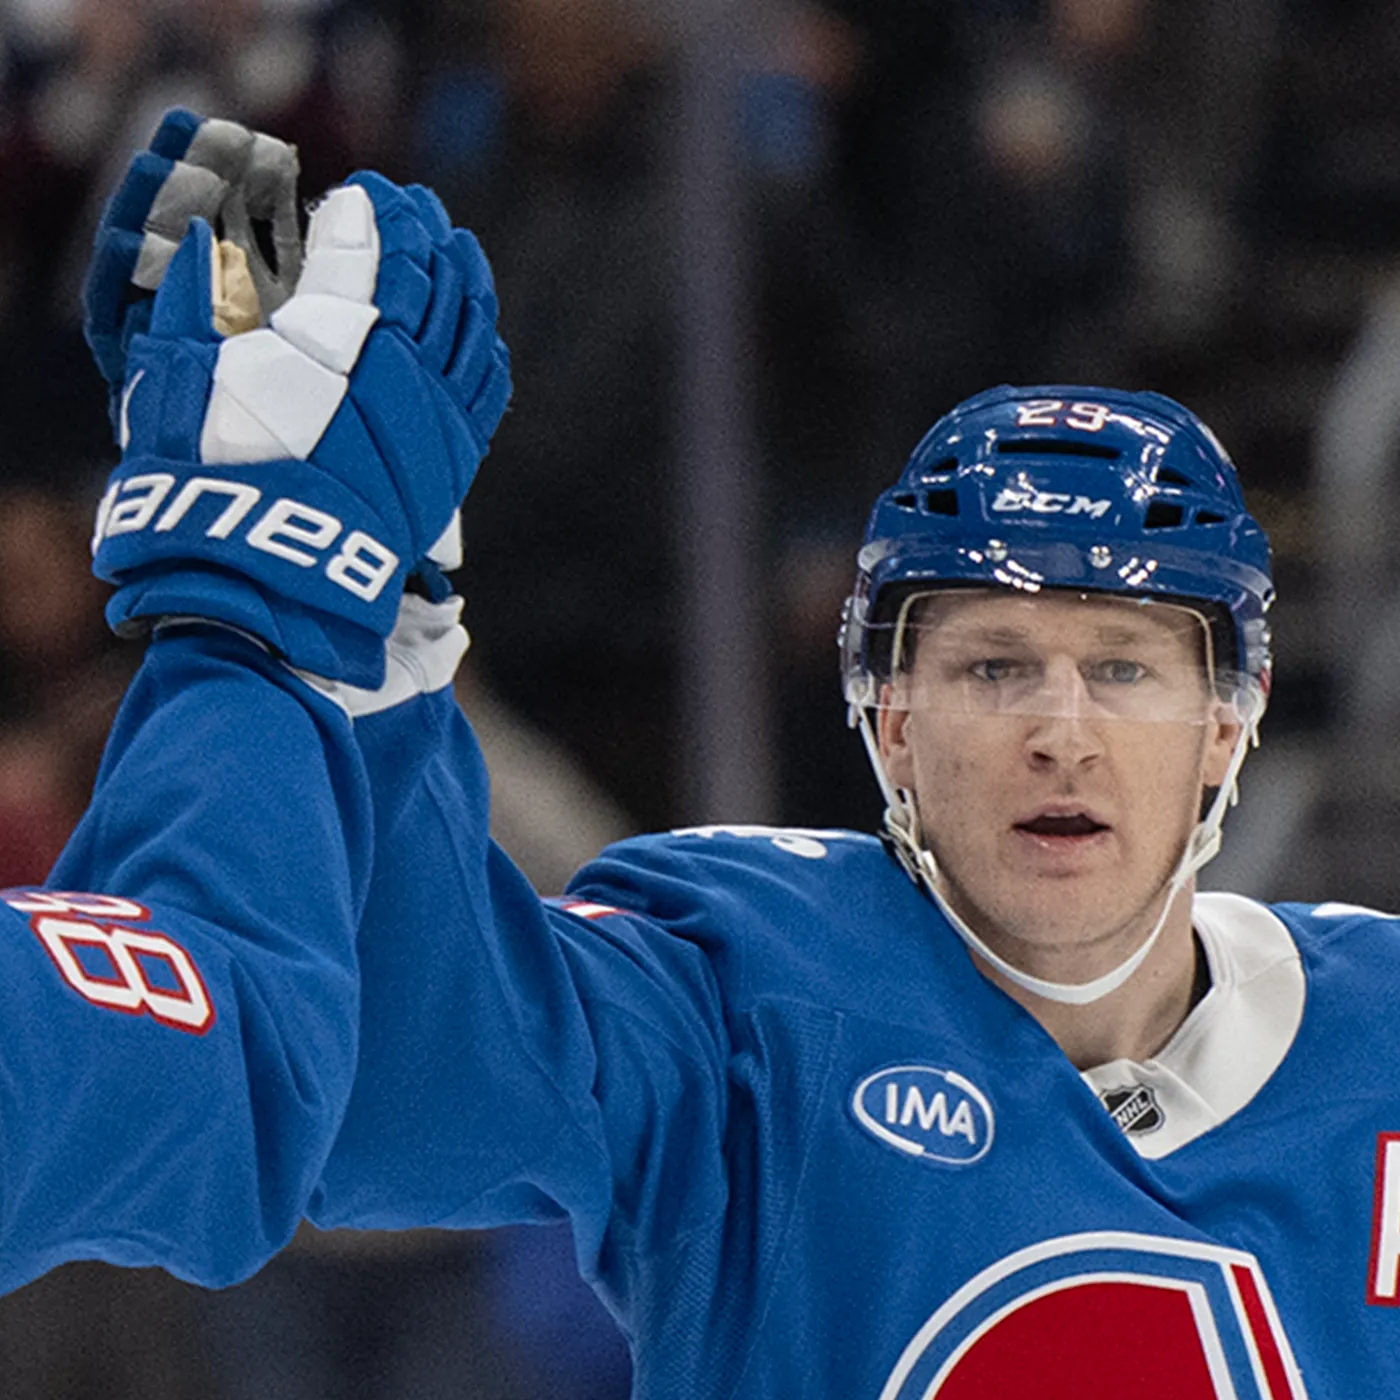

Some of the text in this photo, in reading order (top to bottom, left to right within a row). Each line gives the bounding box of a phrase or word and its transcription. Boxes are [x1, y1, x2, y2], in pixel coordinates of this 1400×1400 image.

[1016, 400, 1110, 432] 29
[992, 492, 1111, 518] CCM
[883, 1082, 976, 1144] IMA
[1114, 1096, 1150, 1128] NHL
